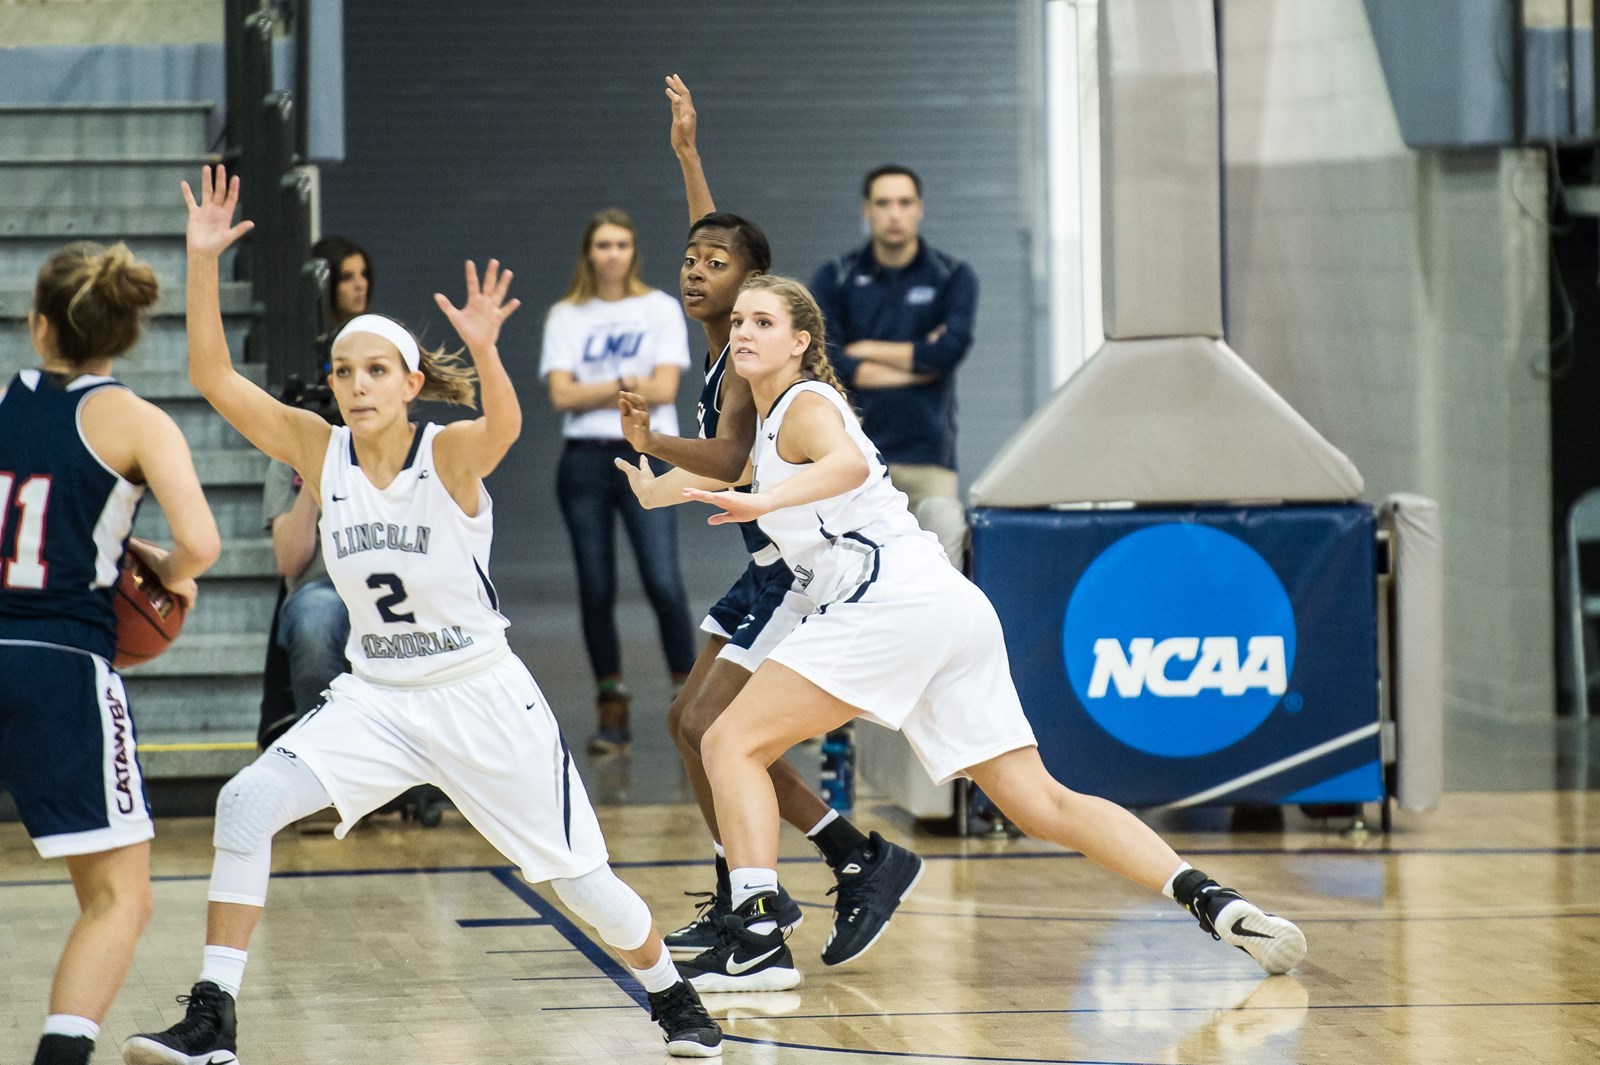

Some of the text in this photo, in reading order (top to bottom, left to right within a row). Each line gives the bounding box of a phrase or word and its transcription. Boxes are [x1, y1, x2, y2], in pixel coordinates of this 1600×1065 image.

[583, 331, 644, 362] LMU
[332, 522, 431, 559] LINCOLN
[365, 572, 416, 624] 2
[1087, 635, 1288, 699] NCAA
